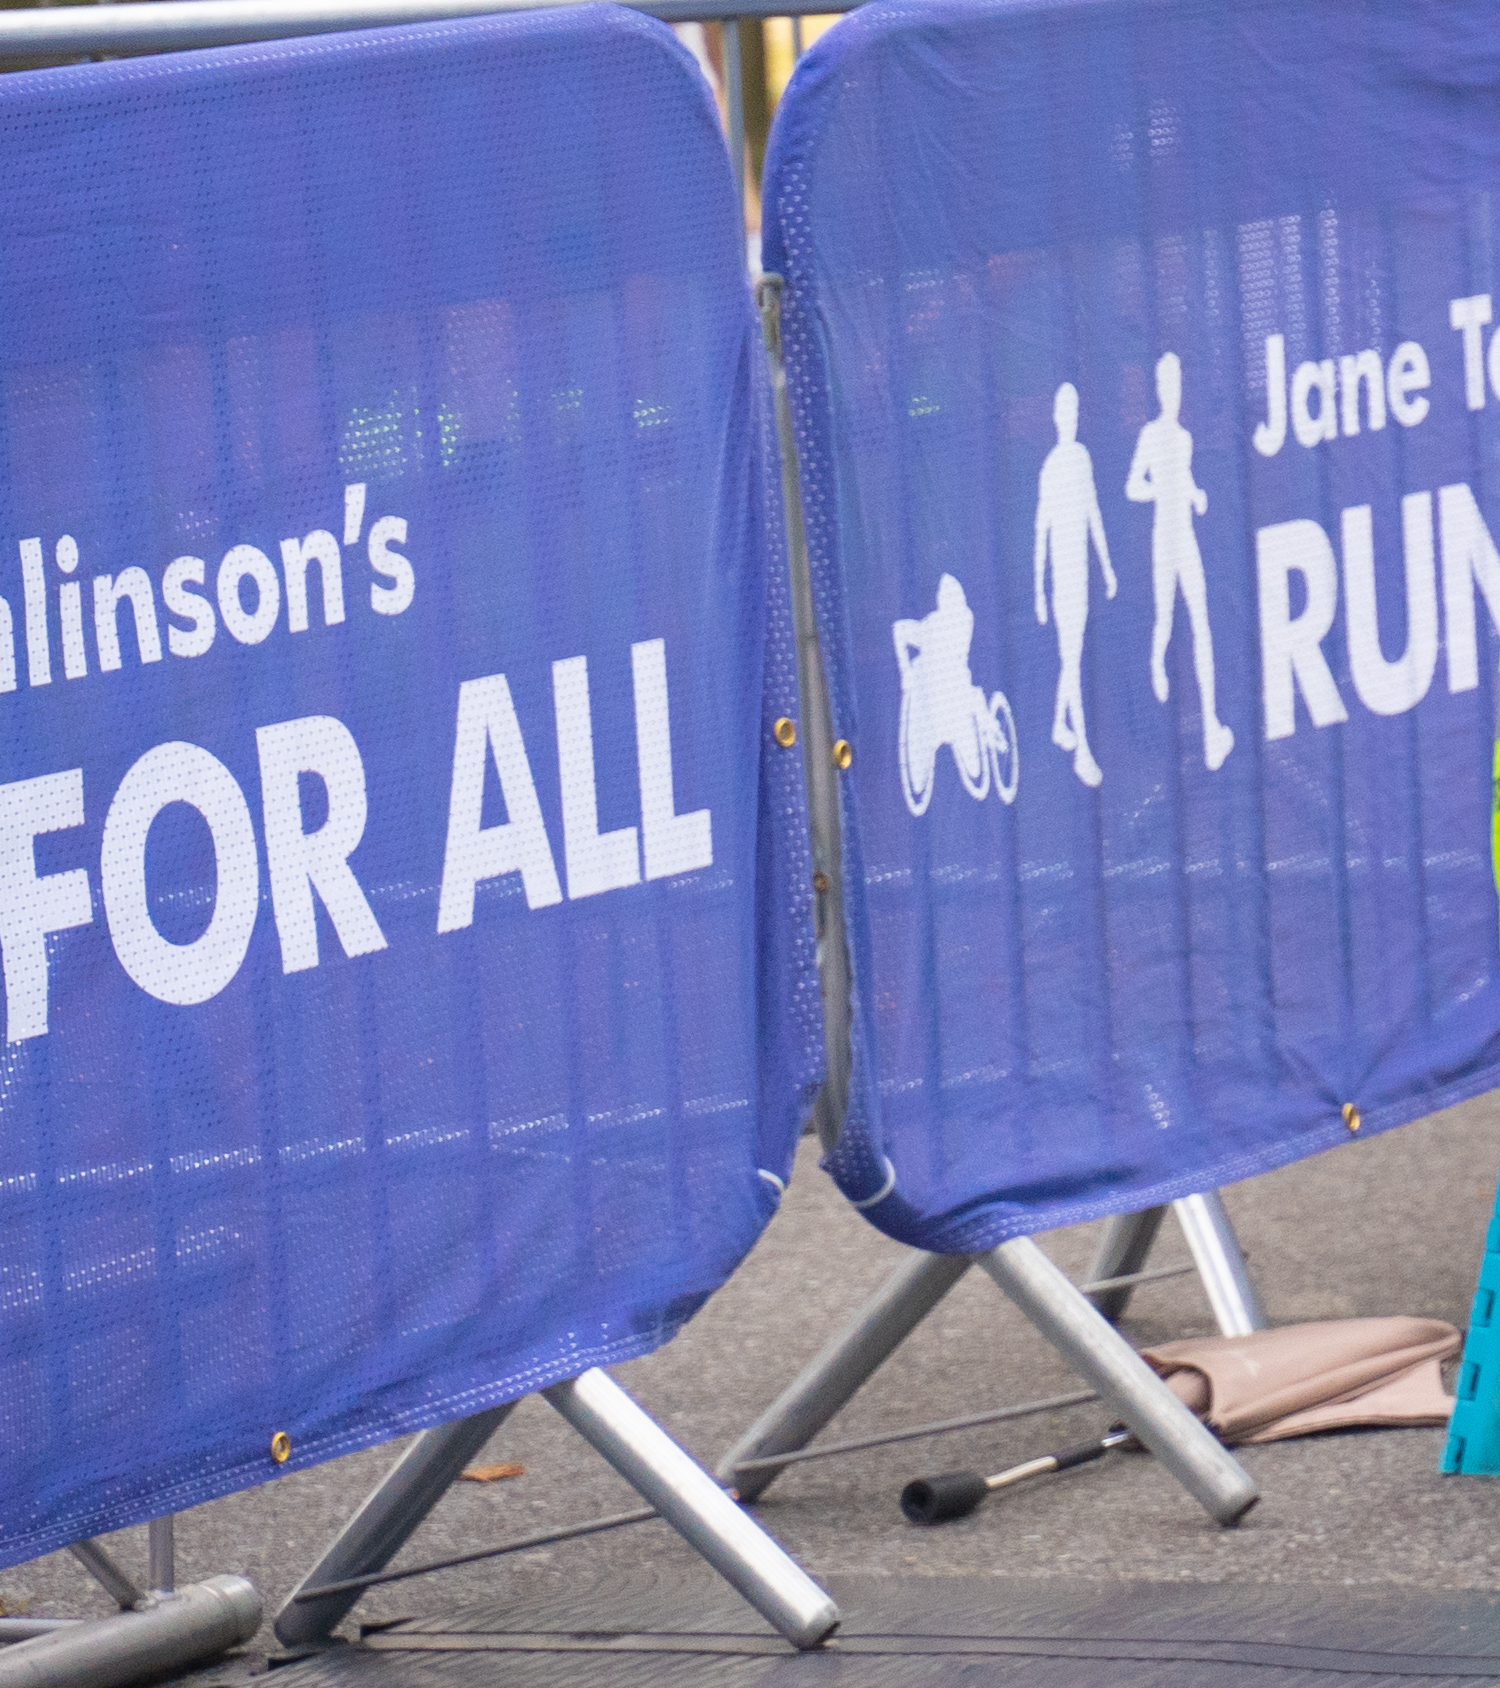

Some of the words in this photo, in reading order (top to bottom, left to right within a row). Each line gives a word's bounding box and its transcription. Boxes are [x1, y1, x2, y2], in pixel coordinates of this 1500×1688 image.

[1252, 333, 1431, 457] Jane
[0, 713, 388, 1041] FOR
[437, 636, 712, 934] ALL
